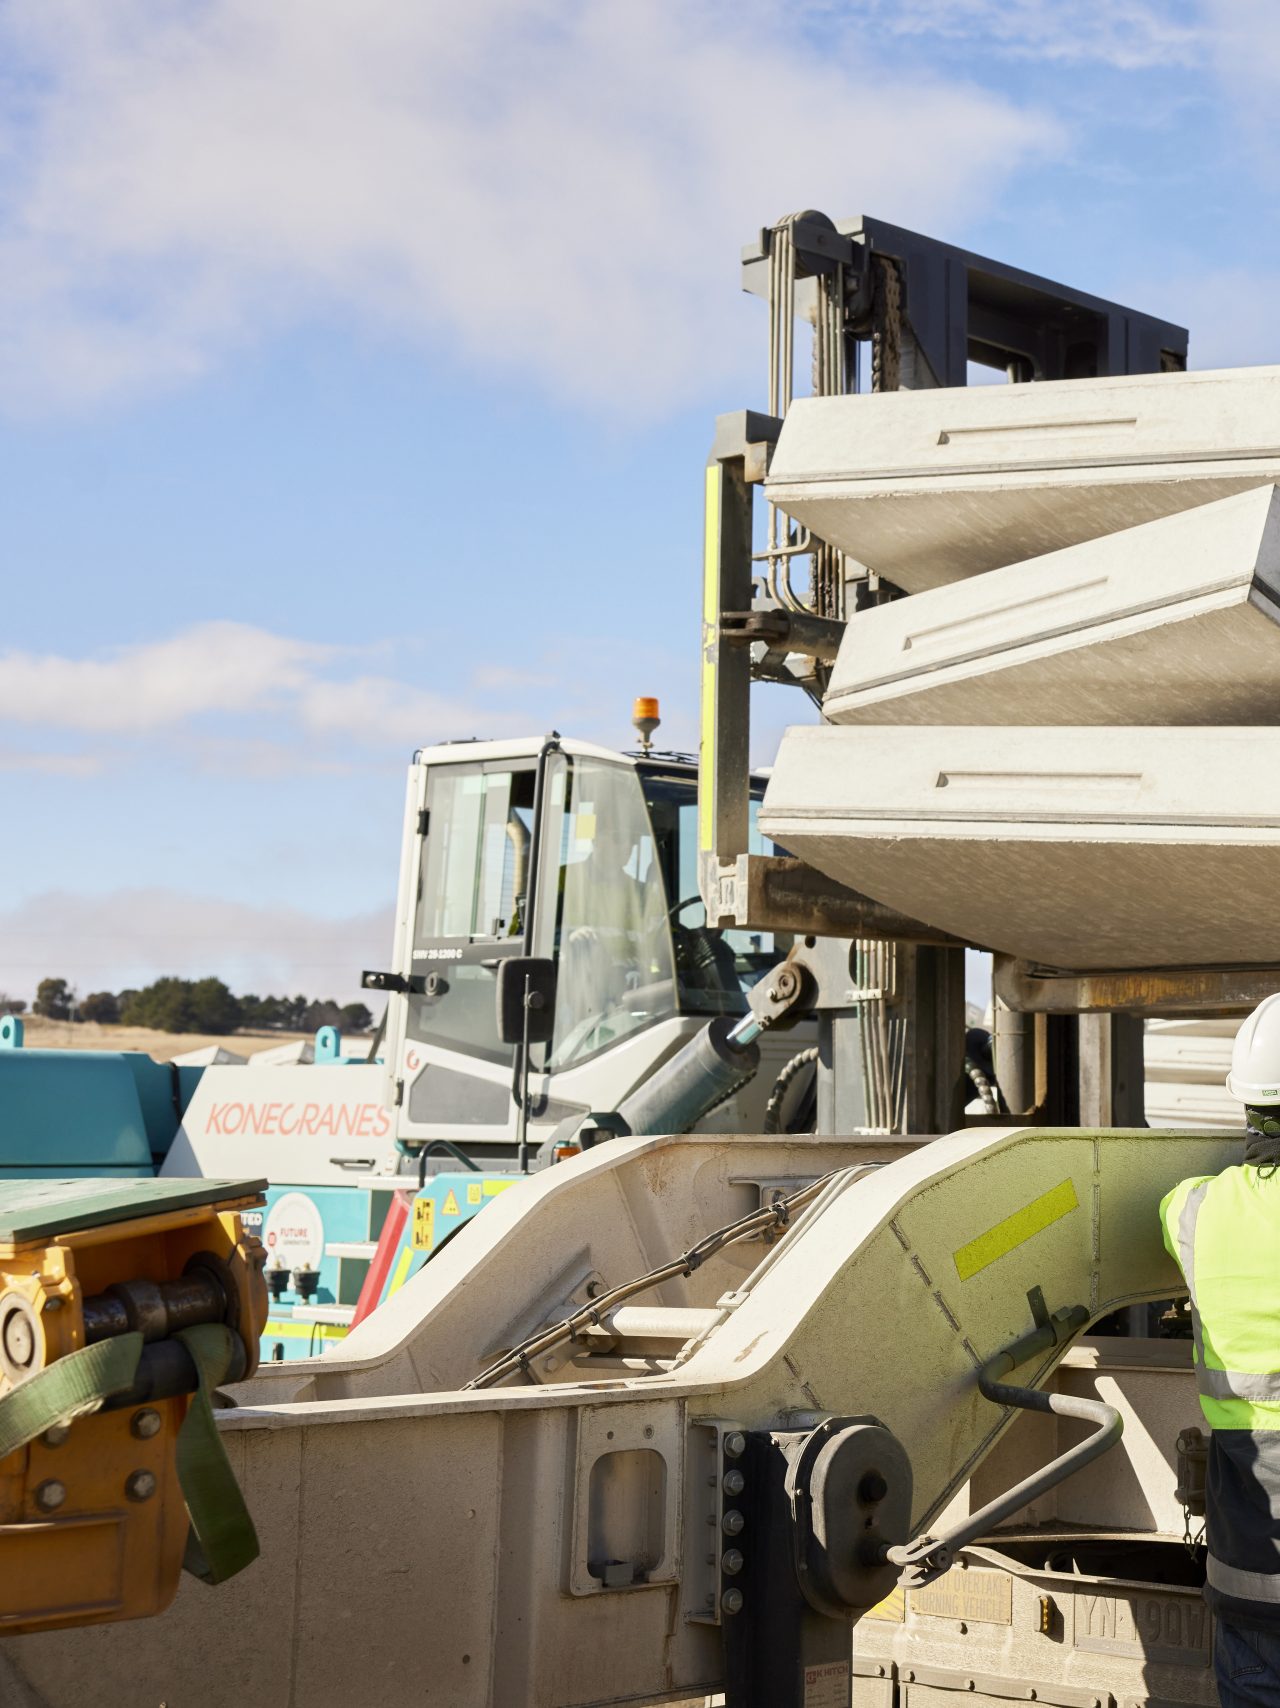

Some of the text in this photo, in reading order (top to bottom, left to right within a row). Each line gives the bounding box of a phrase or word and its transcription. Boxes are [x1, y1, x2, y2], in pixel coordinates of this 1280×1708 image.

[205, 1102, 392, 1137] KONECRANES
[954, 1570, 1006, 1597] OVERTAKE
[917, 1591, 1006, 1621] TURNING VEHICLE
